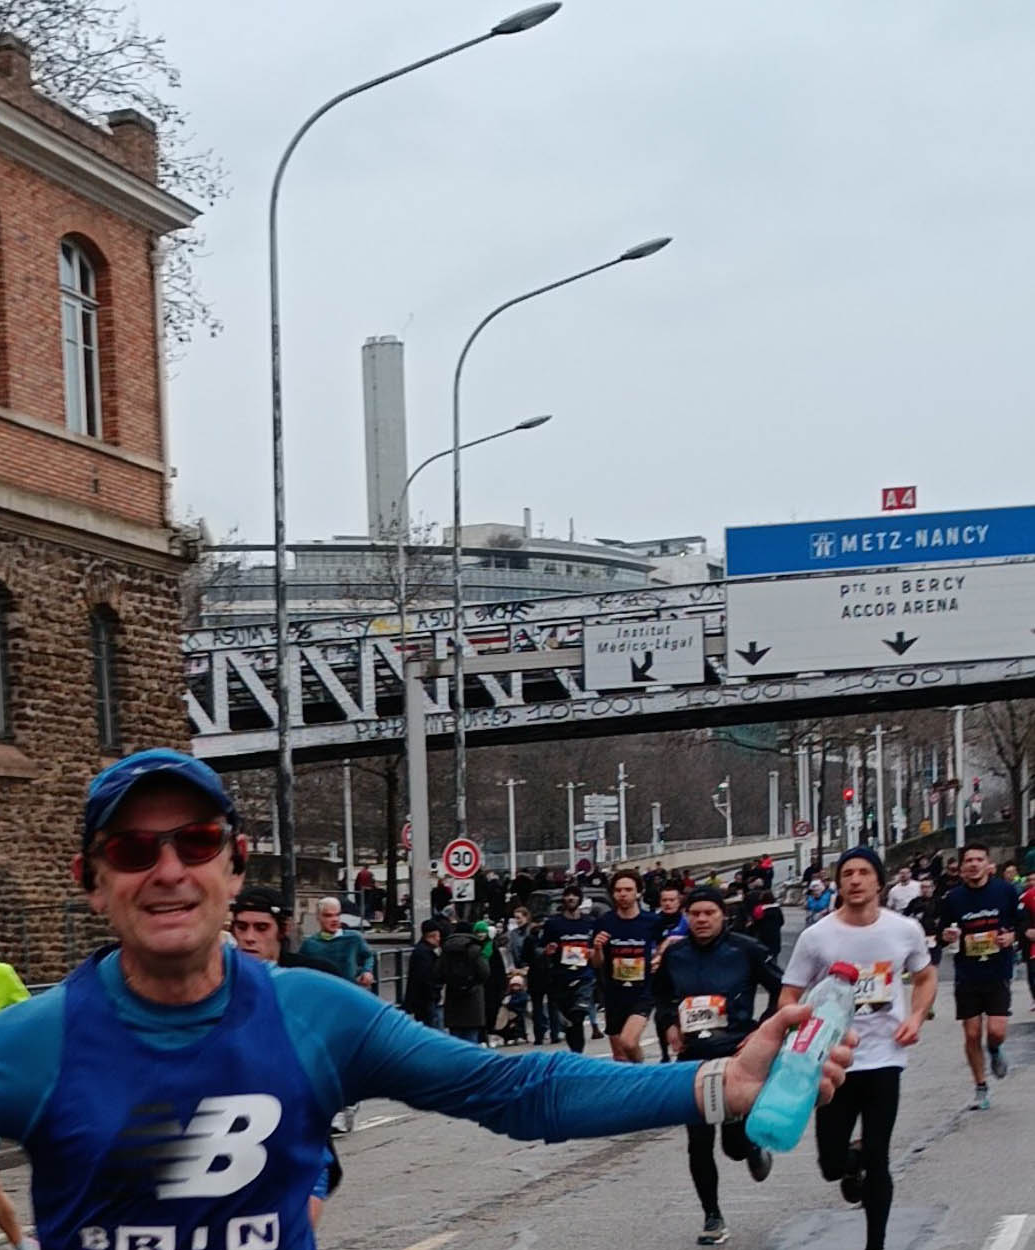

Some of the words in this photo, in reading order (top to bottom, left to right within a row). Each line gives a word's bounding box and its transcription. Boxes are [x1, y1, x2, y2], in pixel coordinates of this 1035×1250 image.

[841, 525, 989, 553] METZ-NANCY
[902, 576, 966, 594] BERCY
[841, 602, 897, 619] ACCOR
[902, 598, 959, 615] ARENA
[617, 625, 670, 639] Institut
[452, 851, 473, 867] 30
